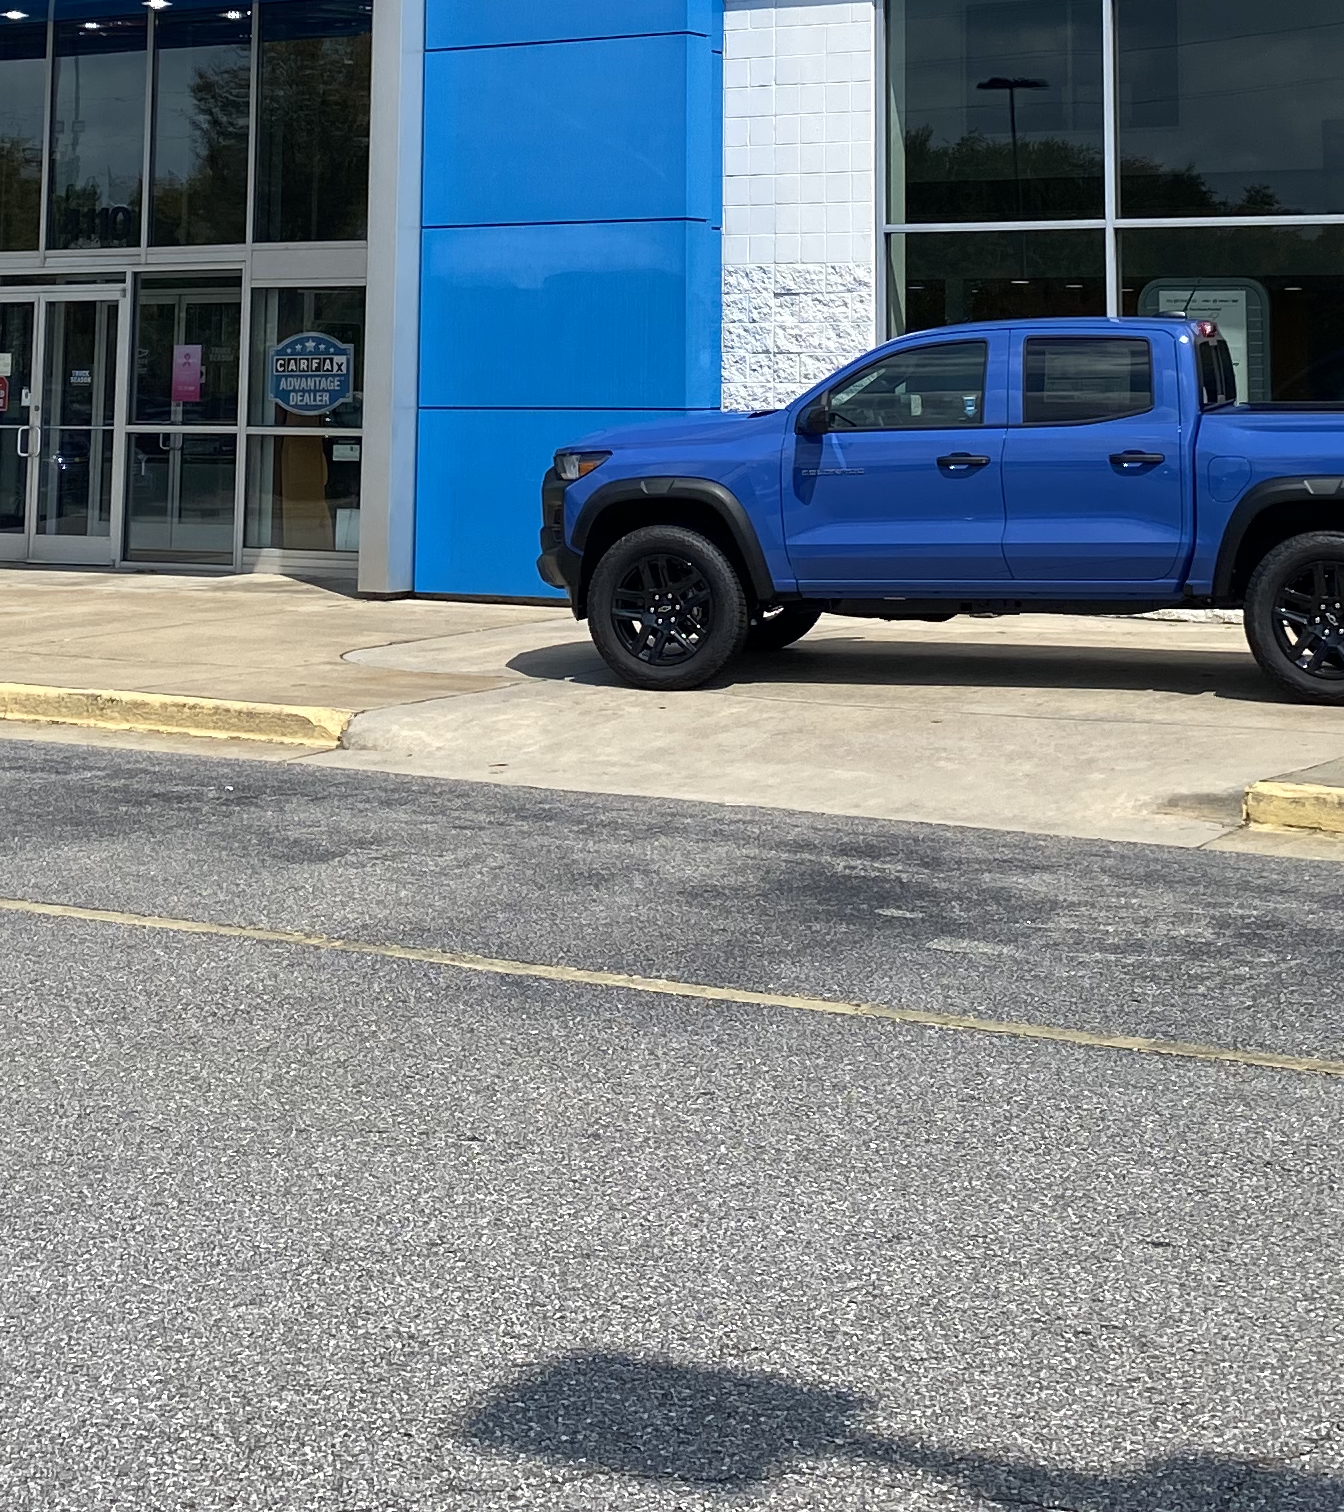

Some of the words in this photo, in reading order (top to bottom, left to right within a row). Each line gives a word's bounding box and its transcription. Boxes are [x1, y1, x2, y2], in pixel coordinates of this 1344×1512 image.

[275, 357, 345, 374] CARFAX
[279, 376, 341, 390] ADVANTAGE
[289, 392, 330, 405] DEALER
